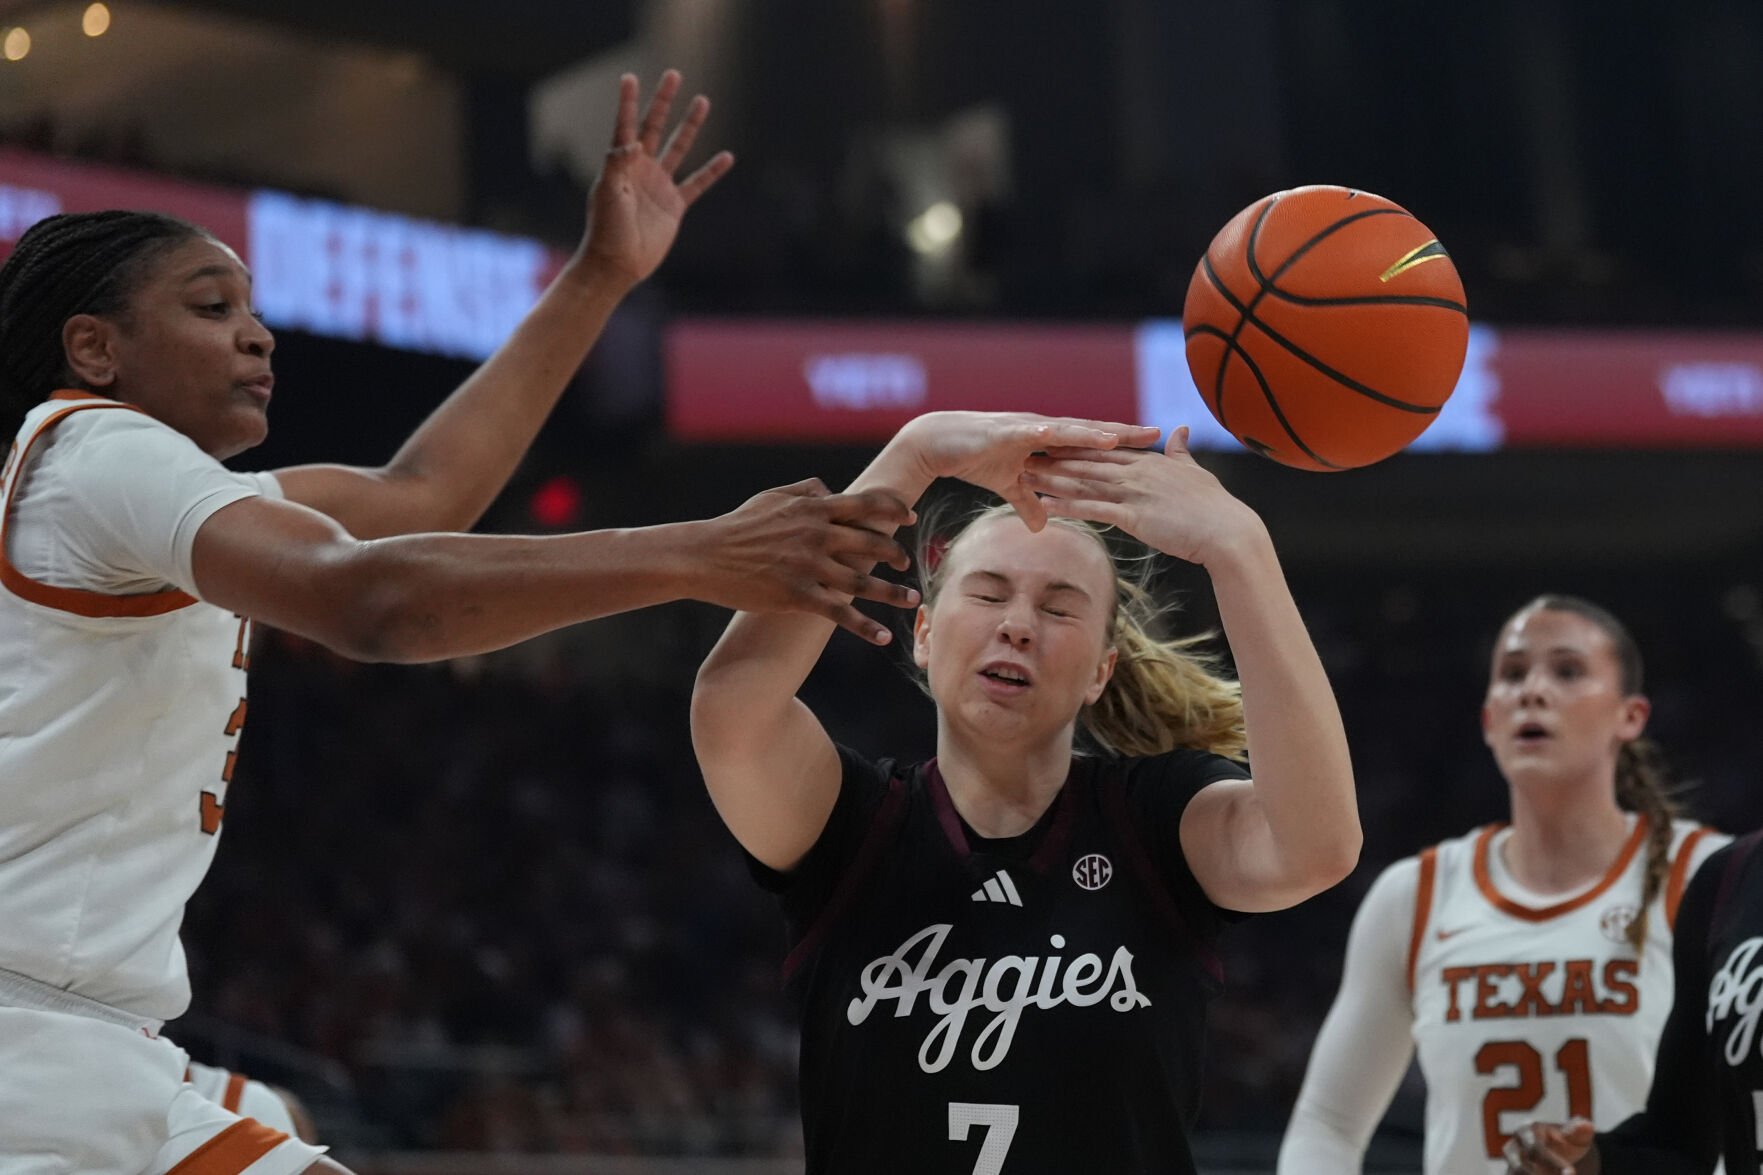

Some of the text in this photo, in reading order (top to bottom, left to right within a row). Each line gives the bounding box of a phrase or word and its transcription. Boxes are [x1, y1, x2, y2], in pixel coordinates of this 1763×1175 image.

[1074, 856, 1111, 889] SEC
[847, 923, 1153, 1073] Aggies
[1441, 959, 1640, 1024] TEXAS
[1474, 1038, 1594, 1160] 21
[948, 1101, 1020, 1175] 7
